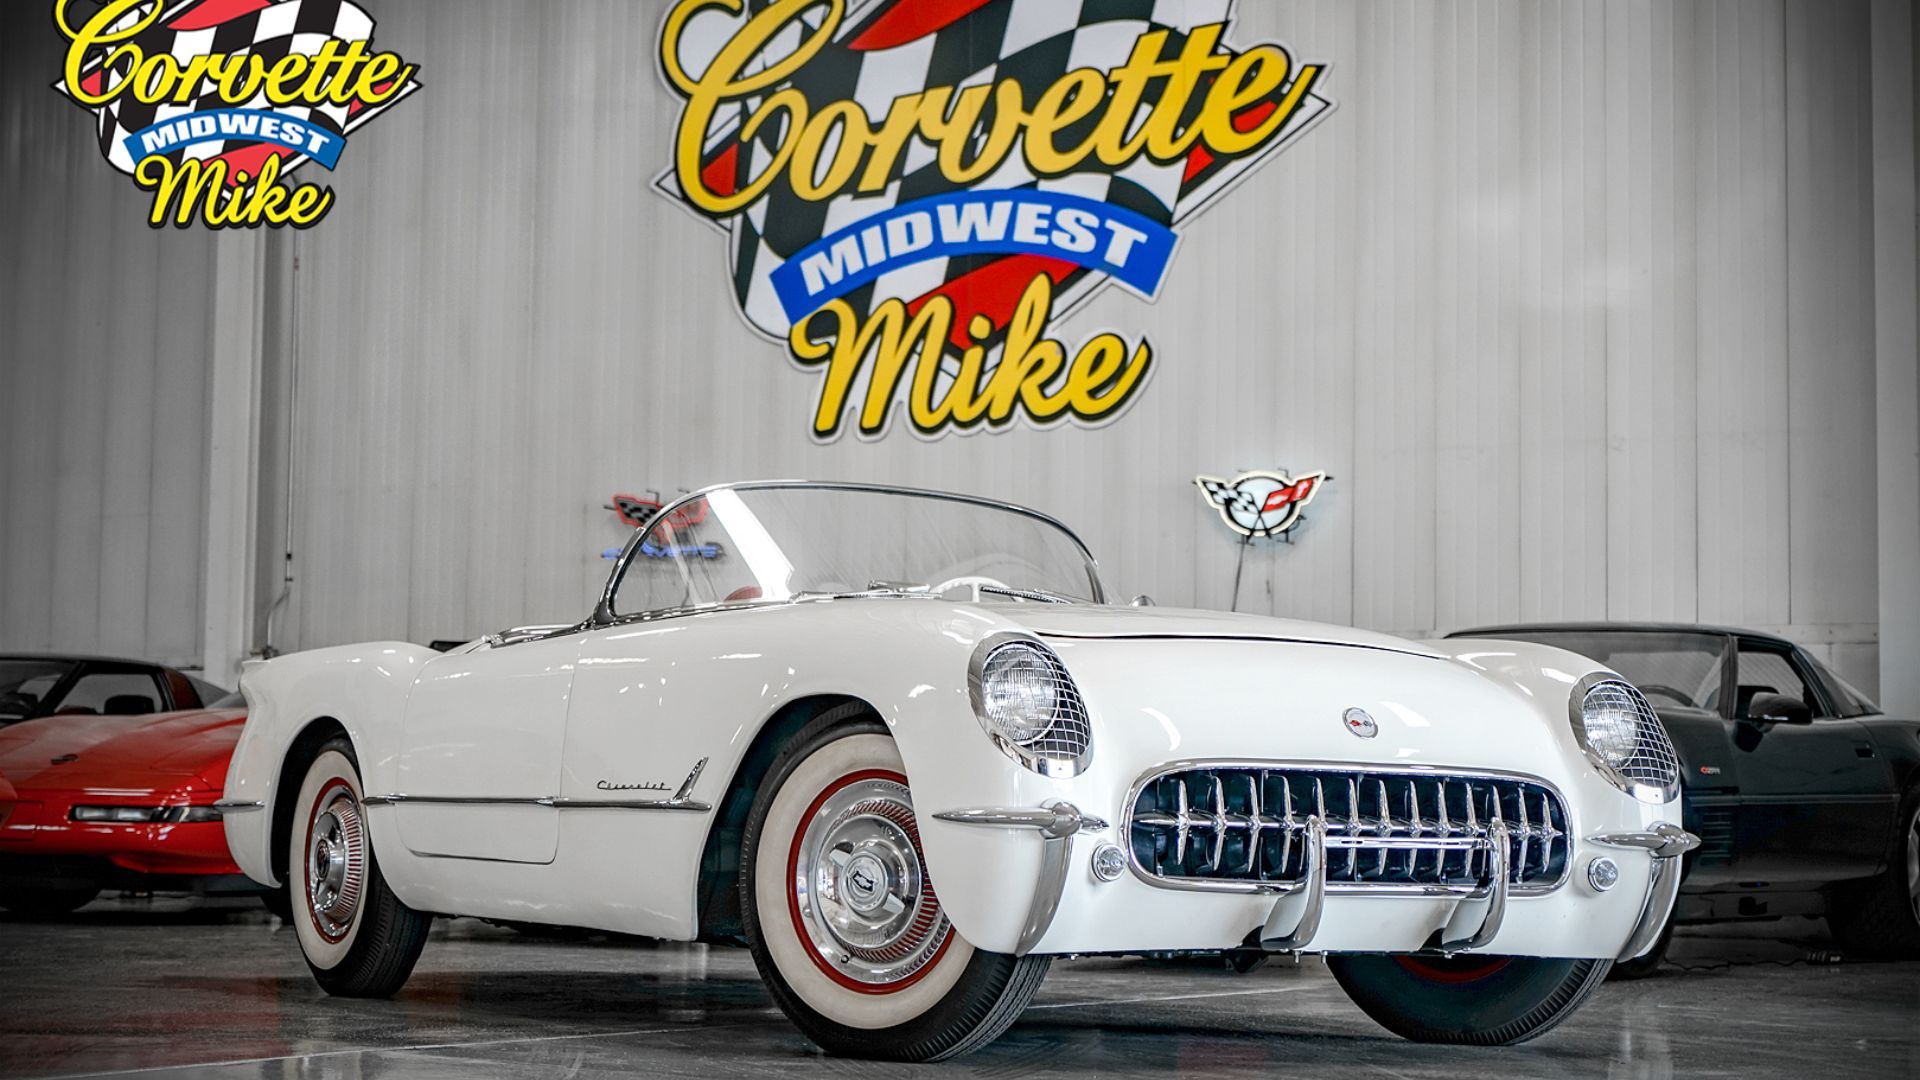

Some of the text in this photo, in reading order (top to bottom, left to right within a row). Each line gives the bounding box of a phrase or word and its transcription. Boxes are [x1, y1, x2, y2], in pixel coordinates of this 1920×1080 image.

[660, 0, 1319, 213] Corvette
[799, 200, 1147, 297] MIDWEST
[791, 271, 1149, 434] Mike
